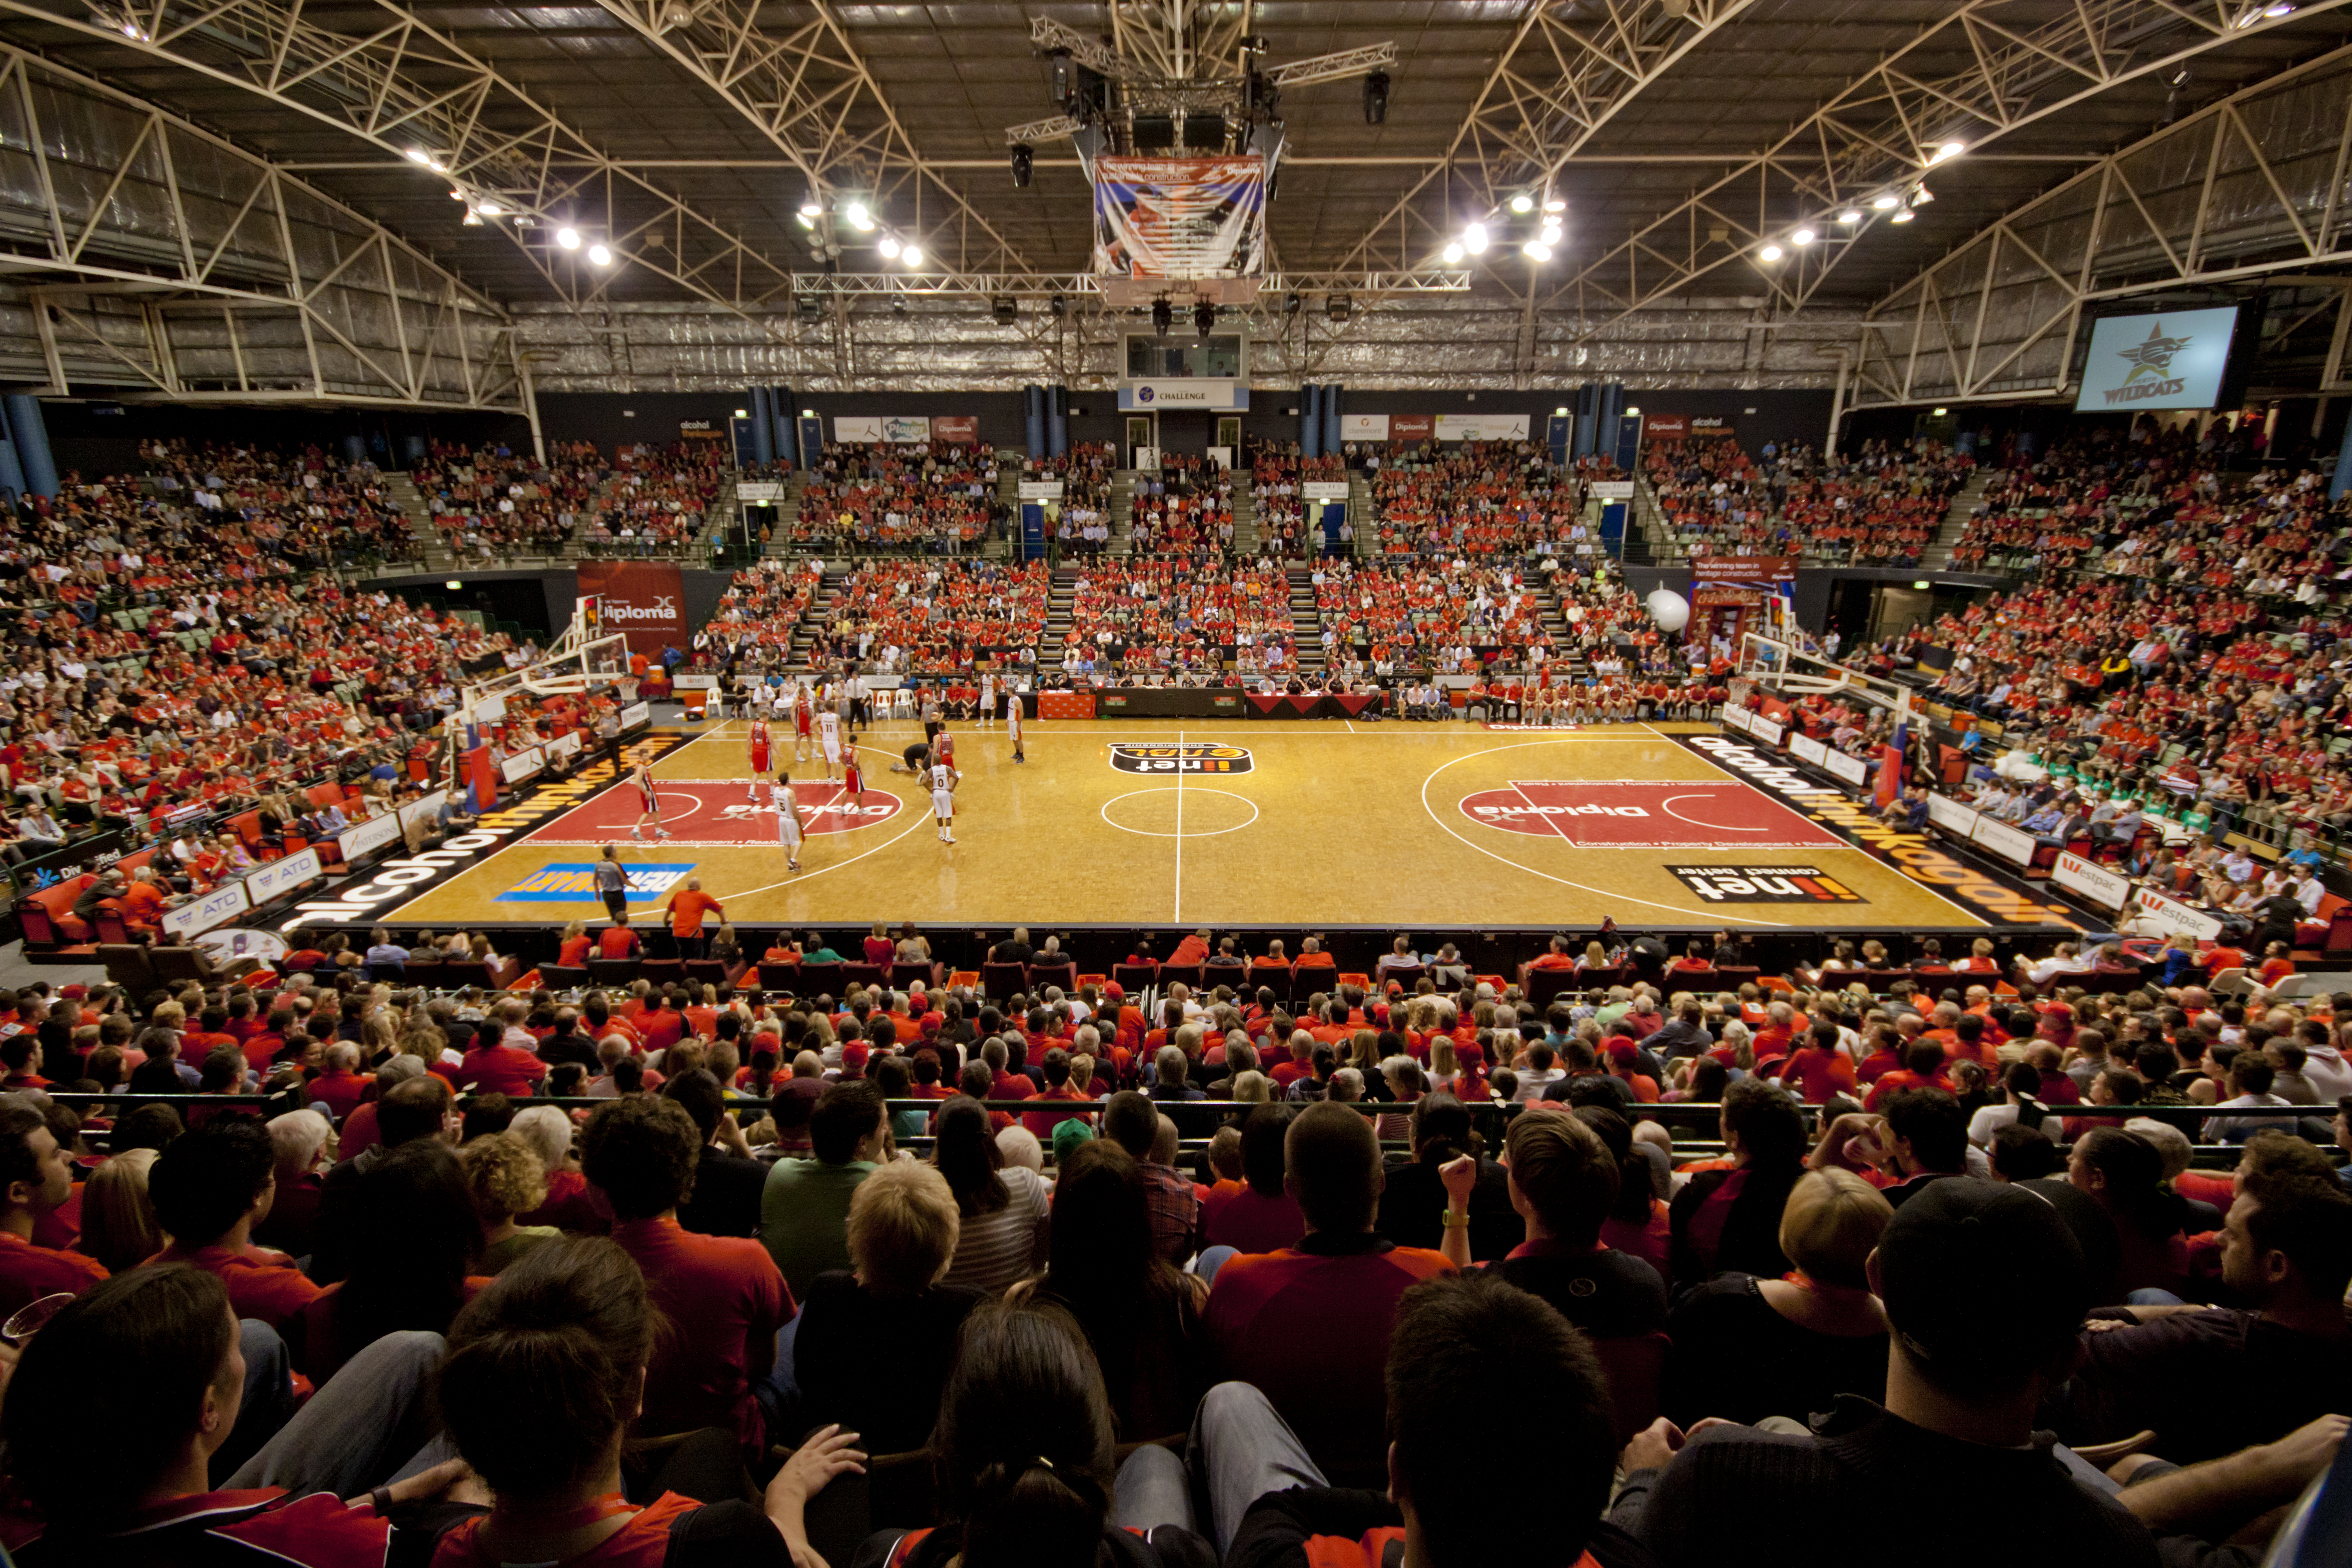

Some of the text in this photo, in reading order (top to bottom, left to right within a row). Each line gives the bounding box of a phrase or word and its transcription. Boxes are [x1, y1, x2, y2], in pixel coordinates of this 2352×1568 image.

[1103, 161, 1116, 170] The
[1116, 162, 1145, 172] winning
[1147, 162, 1166, 171] team
[1227, 165, 1260, 176] Diploma
[2103, 377, 2188, 406] WILDCATS
[680, 420, 710, 429] alcohol
[1395, 422, 1428, 431] Diploma
[1649, 423, 1683, 431] Diploma
[1692, 417, 1722, 426] alcohol
[888, 424, 925, 435] Player
[939, 425, 971, 433] Diploma
[1725, 709, 1747, 725] Diploma
[825, 724, 832, 733] 11
[1753, 722, 1777, 739] Diploma
[1136, 760, 1230, 772] iinet
[1689, 736, 1841, 794] alcohol
[937, 778, 944, 787] 0
[779, 802, 786, 812] 5
[1473, 803, 1650, 816] Diploma
[355, 824, 397, 850] PATERSONS
[59, 848, 121, 879] Divfied
[1677, 867, 1739, 876] better
[2062, 856, 2116, 891] Westpac
[1688, 876, 1860, 900] iinet
[2141, 892, 2205, 932] Westpac
